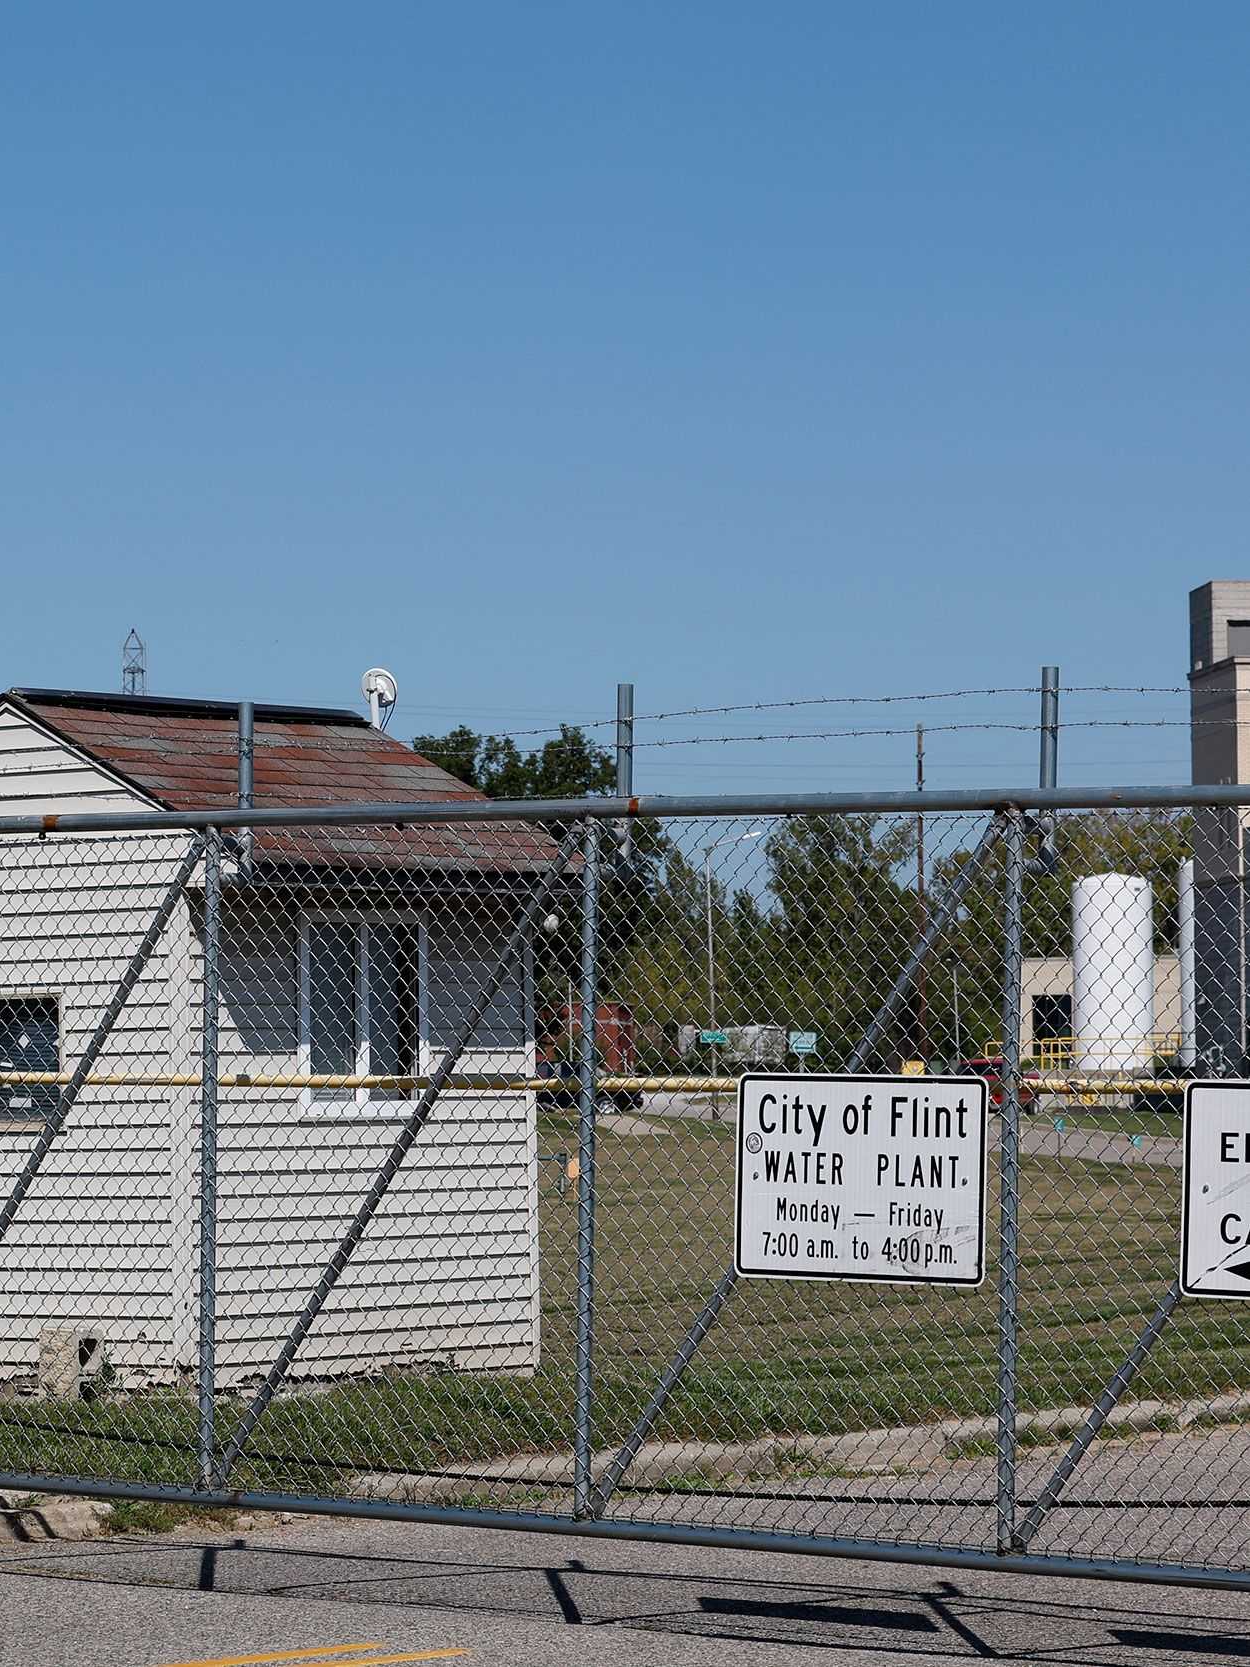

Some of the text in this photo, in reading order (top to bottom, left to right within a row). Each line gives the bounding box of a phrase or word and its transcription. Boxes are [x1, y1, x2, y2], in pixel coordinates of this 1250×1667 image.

[758, 1093, 968, 1147] City of Flint
[764, 1150, 959, 1189] WATER PLANT
[776, 1197, 840, 1230] Monday
[889, 1201, 944, 1235] Friday
[762, 1231, 958, 1269] 7:00 a.m. to 4:00 p.m.
